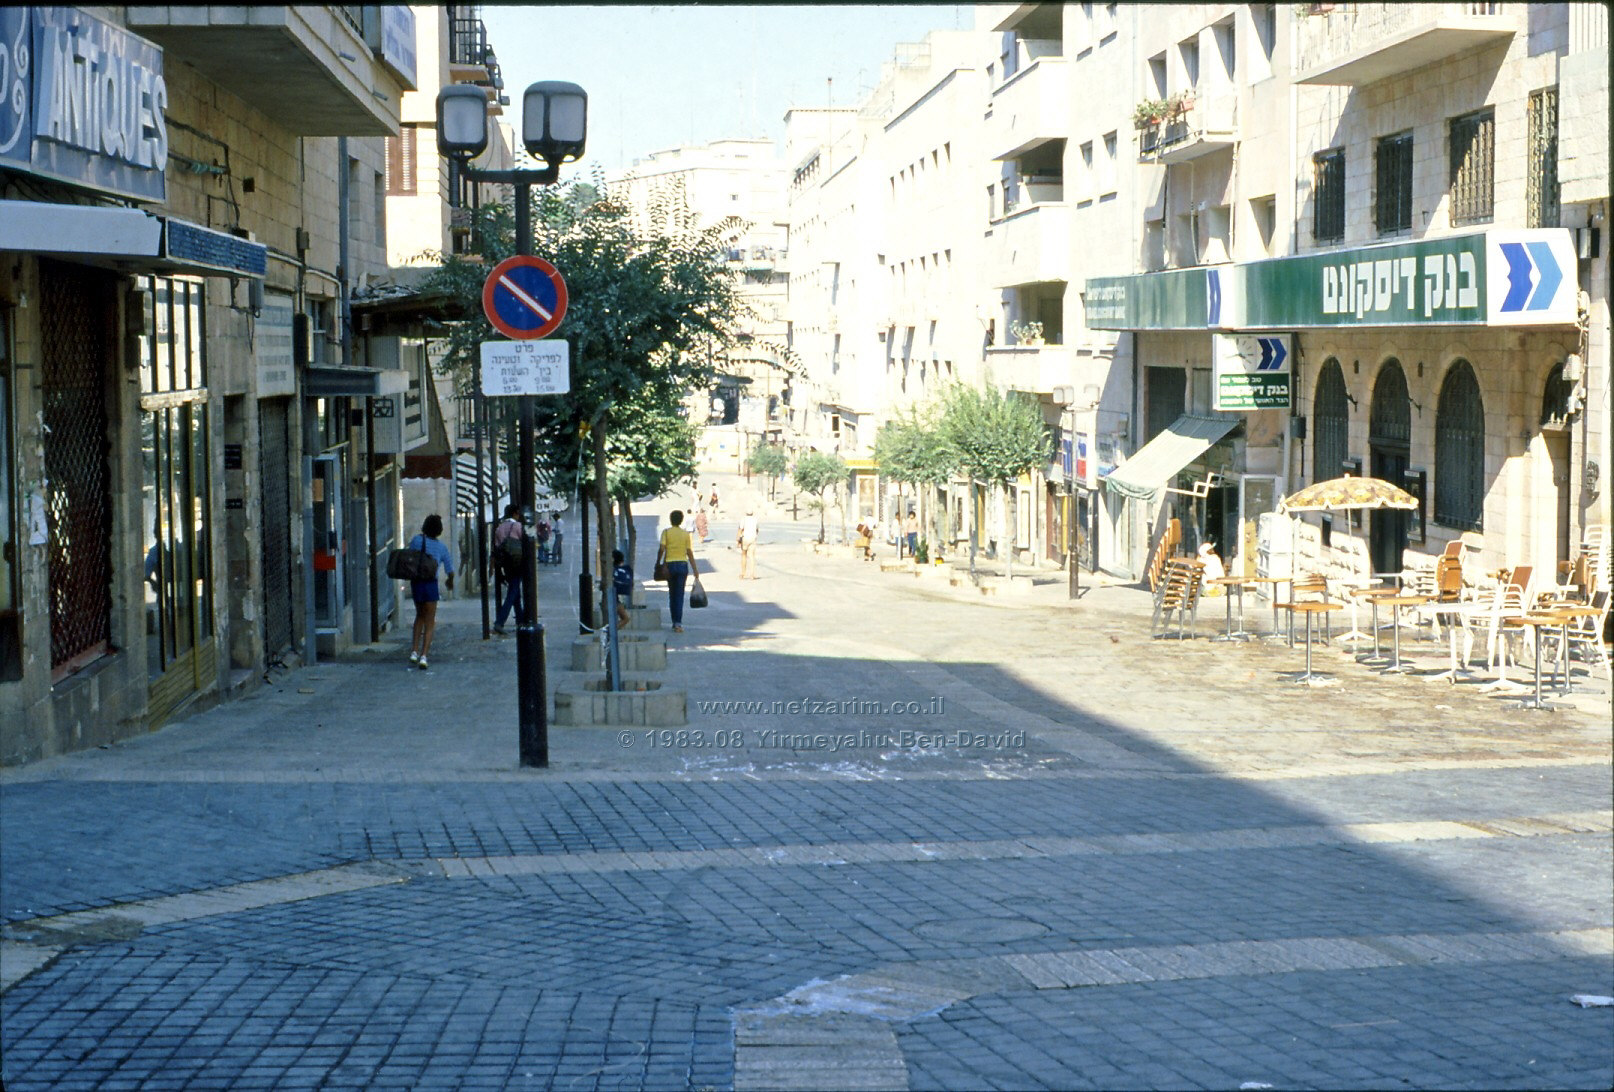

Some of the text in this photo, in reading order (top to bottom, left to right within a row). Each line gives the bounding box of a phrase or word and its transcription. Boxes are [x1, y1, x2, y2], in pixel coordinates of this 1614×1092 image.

[37, 25, 168, 172] ANTIQUES
[1323, 251, 1478, 319] בנק דיסקונט
[515, 344, 534, 353] פרט
[491, 354, 562, 368] לפריקה וטעינה
[539, 367, 552, 377] בין
[1266, 385, 1289, 397] בנק
